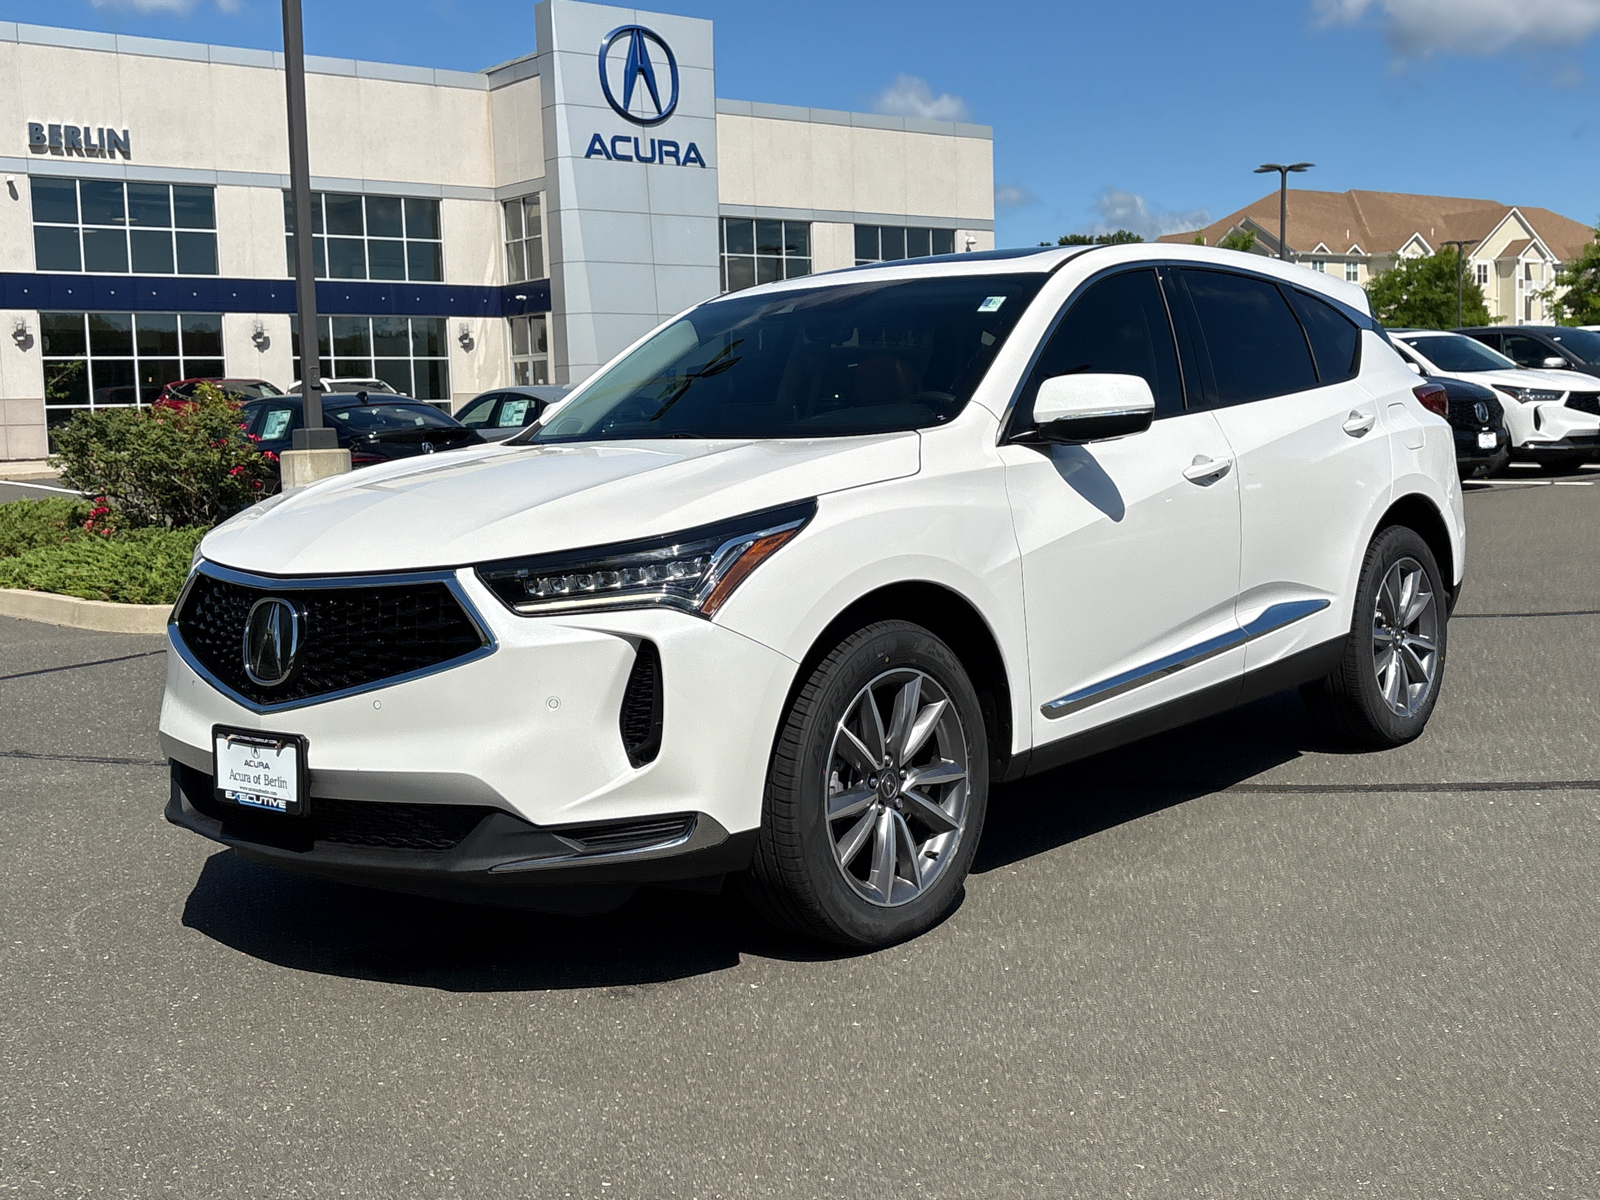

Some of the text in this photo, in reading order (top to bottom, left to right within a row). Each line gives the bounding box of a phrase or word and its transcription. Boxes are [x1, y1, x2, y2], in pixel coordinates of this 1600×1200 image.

[28, 122, 131, 160] BERLIN
[584, 132, 706, 169] ACURA
[244, 759, 270, 770] ACURA
[229, 769, 288, 789] Acura of Berlin
[225, 790, 286, 808] EXECUTIVE
